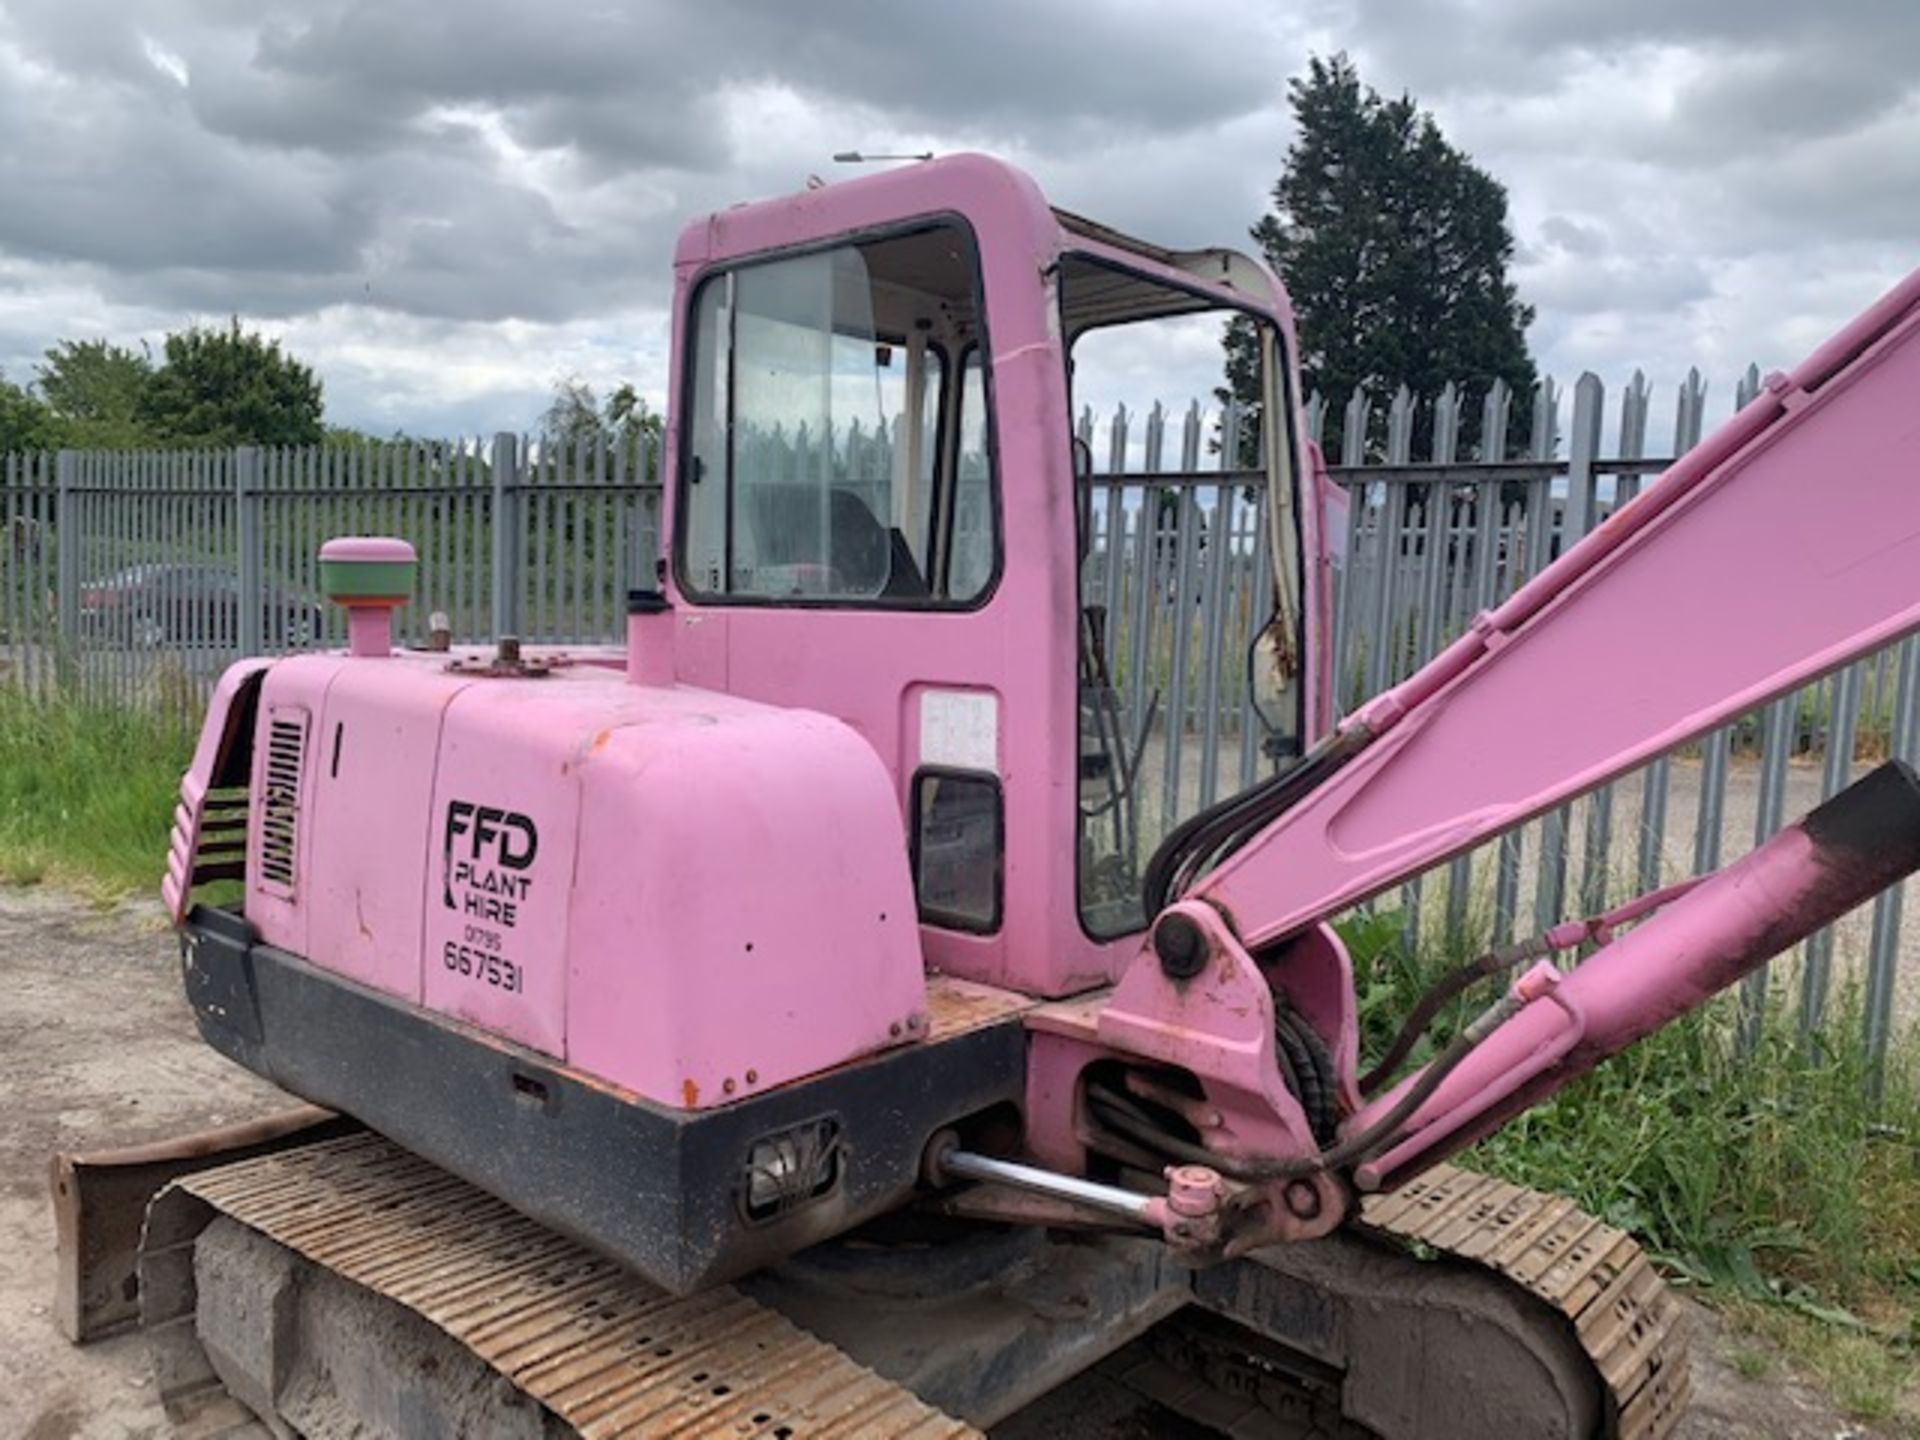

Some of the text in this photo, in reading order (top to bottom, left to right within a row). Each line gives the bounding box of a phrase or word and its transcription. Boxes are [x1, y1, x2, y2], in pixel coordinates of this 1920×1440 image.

[444, 800, 538, 871] FFD
[455, 862, 533, 901] PLANT
[464, 893, 517, 927] HIRE
[444, 941, 523, 994] 667531
